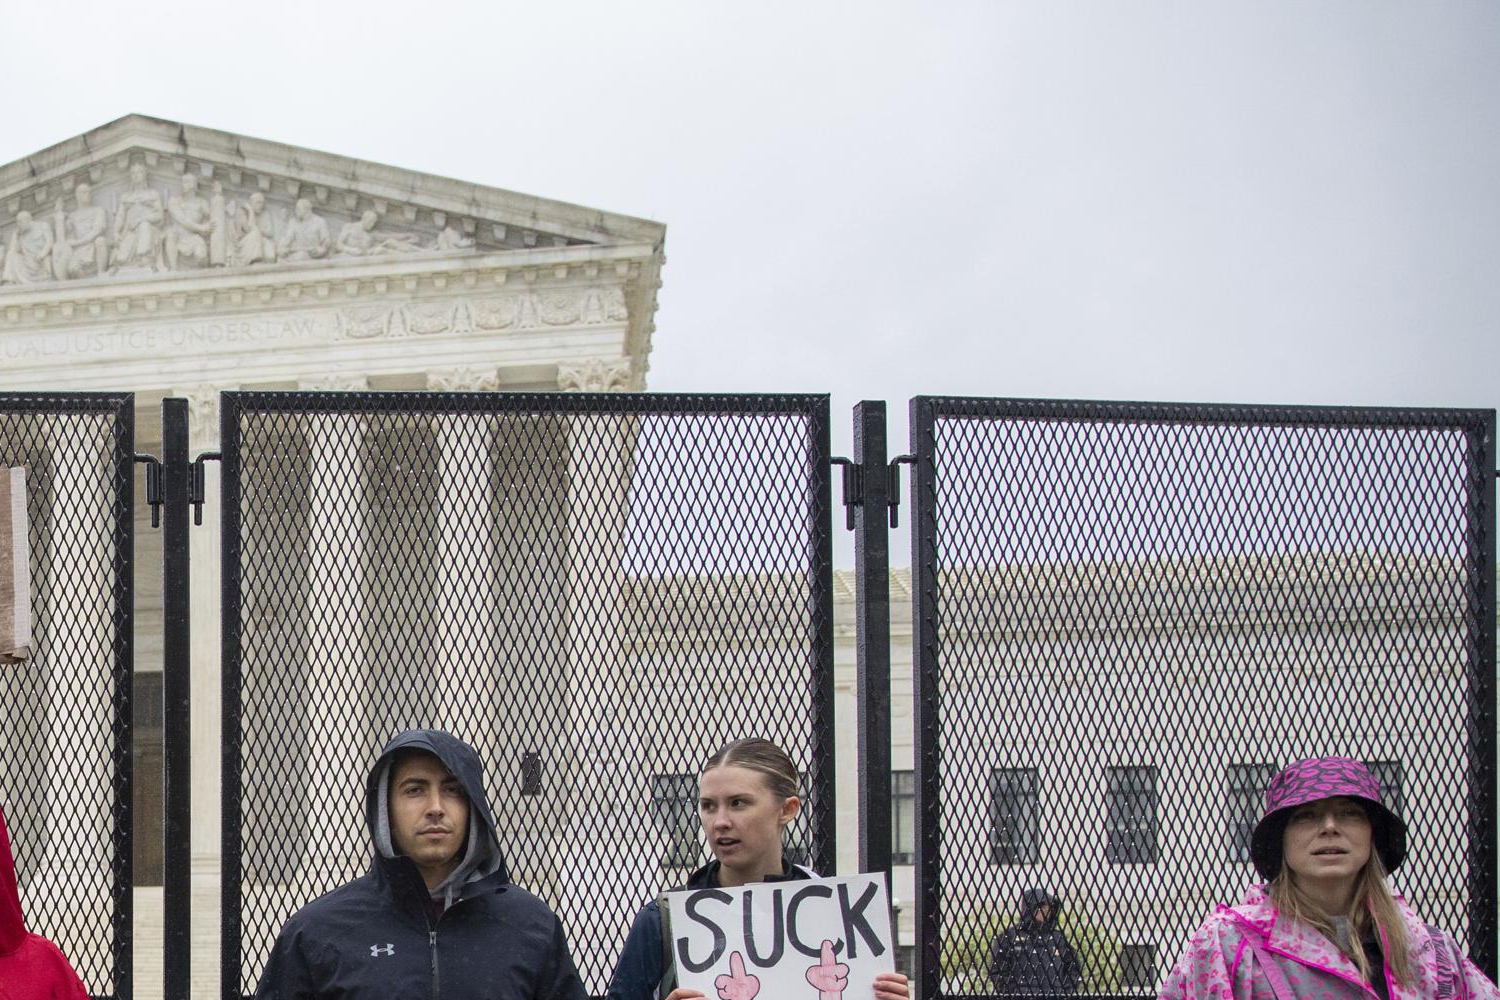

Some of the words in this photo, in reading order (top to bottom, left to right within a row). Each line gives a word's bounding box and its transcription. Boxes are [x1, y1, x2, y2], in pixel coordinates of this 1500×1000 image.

[59, 327, 156, 355] JUSTICE
[169, 322, 253, 346] UNDER
[265, 317, 315, 339] LAW
[676, 881, 886, 974] SUCK
